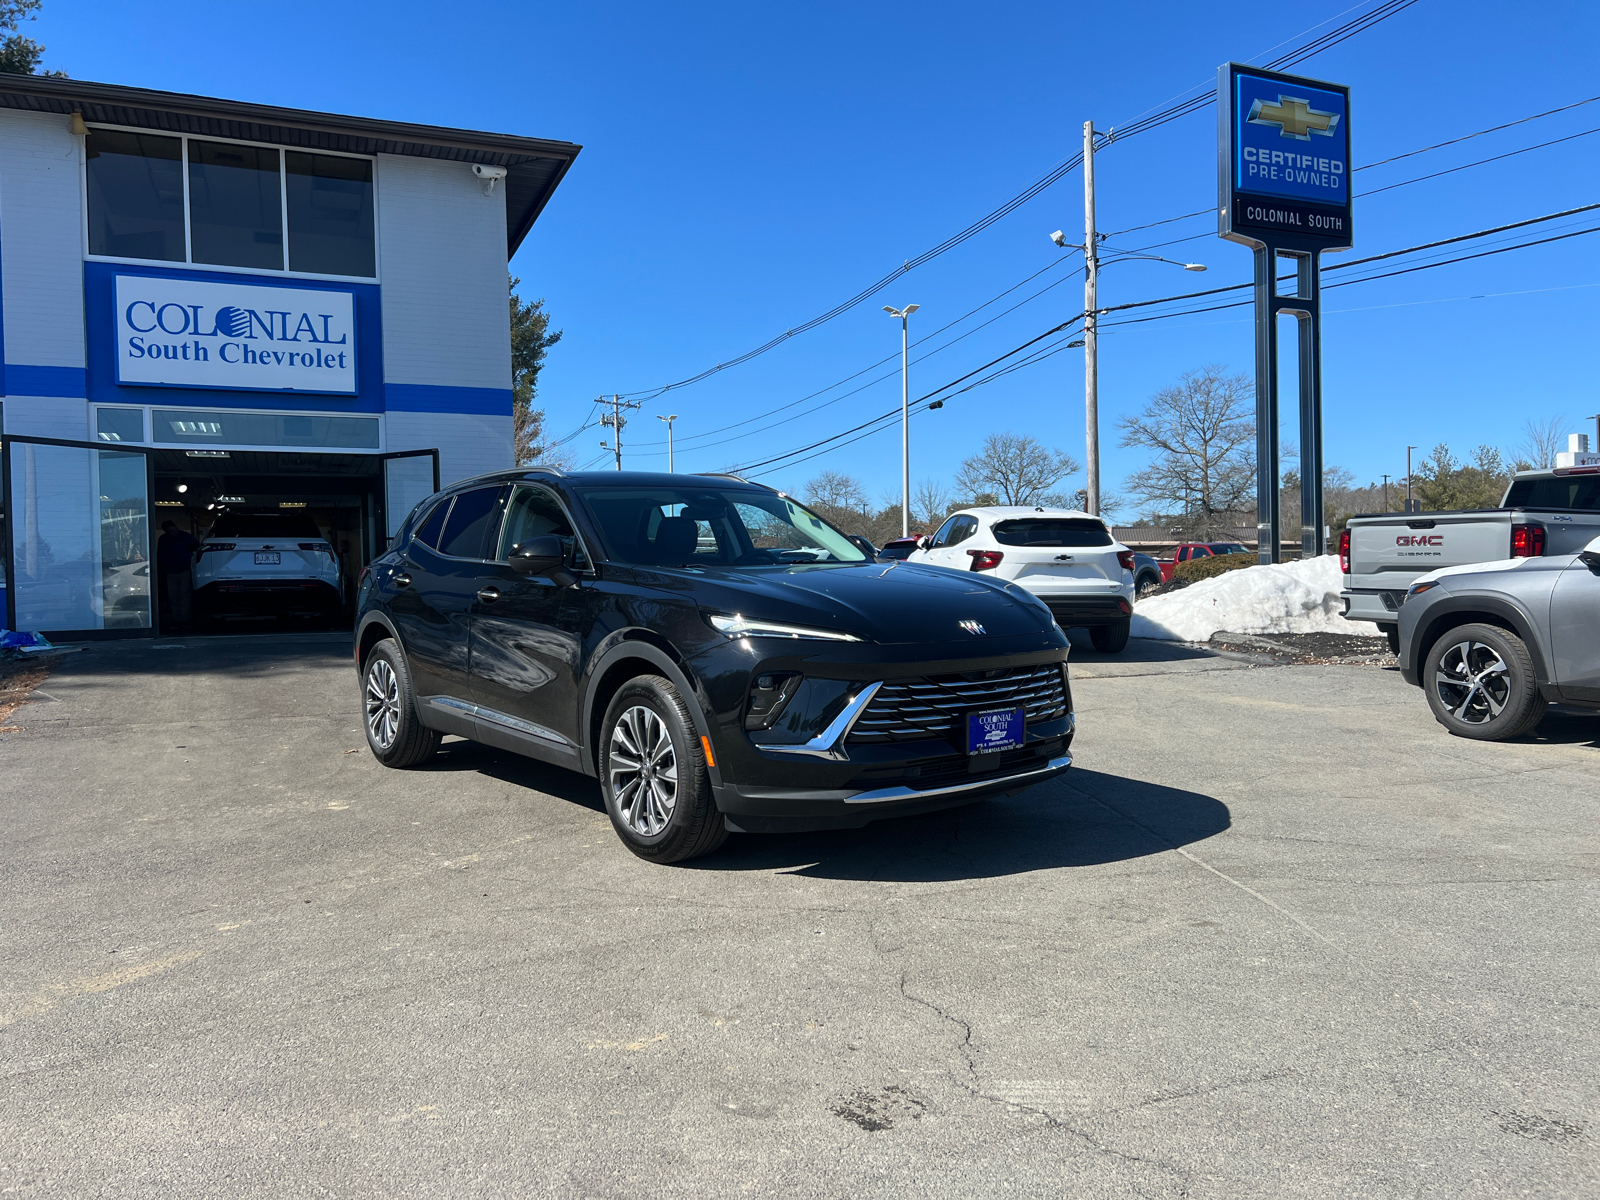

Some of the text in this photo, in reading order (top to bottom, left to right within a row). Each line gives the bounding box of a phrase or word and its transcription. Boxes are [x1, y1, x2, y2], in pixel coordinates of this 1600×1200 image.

[1243, 146, 1344, 175] CERTIFIED
[1249, 163, 1339, 189] PRE-OWNED
[1246, 206, 1342, 231] COLONIAL SOUTH
[125, 300, 347, 345] COLONIAL
[128, 336, 347, 370] South Chevrolet
[1396, 535, 1444, 546] GMC
[979, 713, 1013, 724] COLONIAL
[984, 721, 1008, 731] SOUTH
